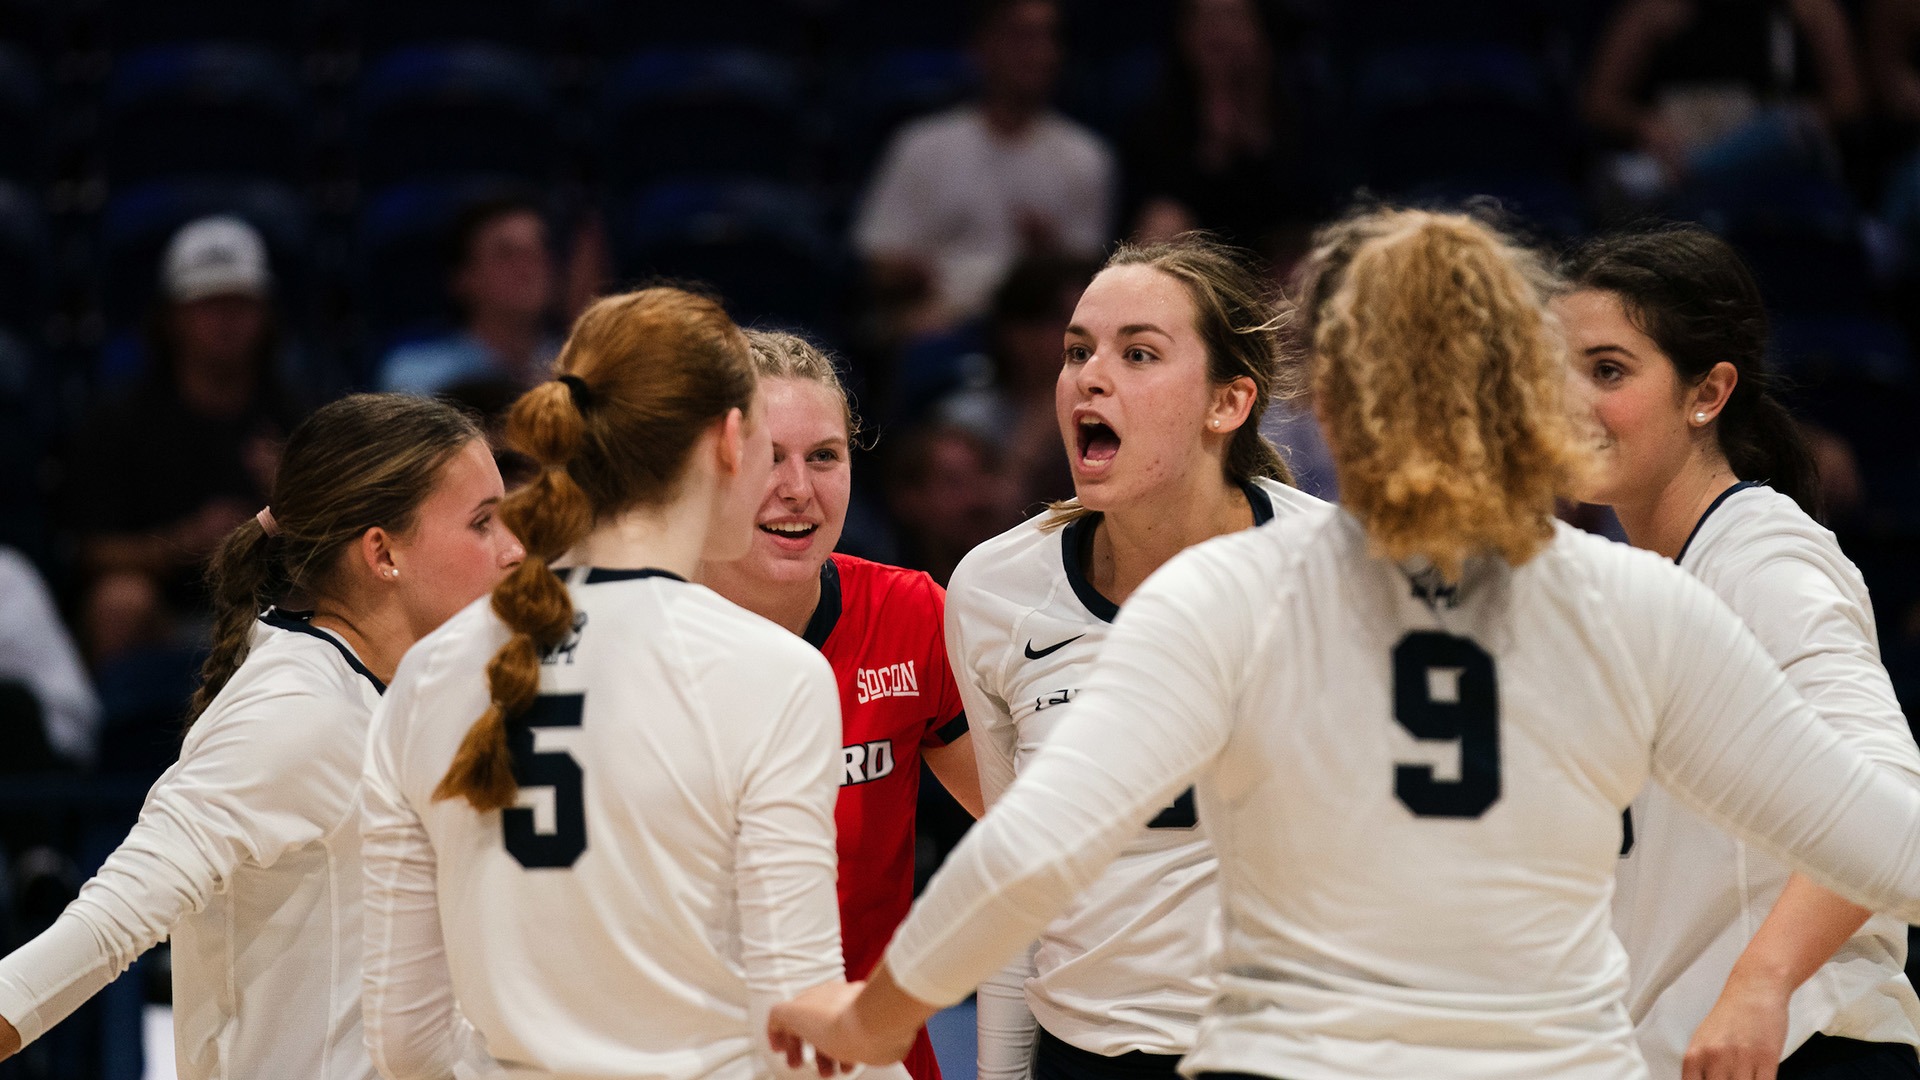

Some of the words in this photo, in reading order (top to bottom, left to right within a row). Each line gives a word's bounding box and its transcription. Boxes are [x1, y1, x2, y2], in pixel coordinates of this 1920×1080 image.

[857, 660, 919, 705] SOCON
[1393, 630, 1501, 819] 9
[502, 692, 588, 869] 5
